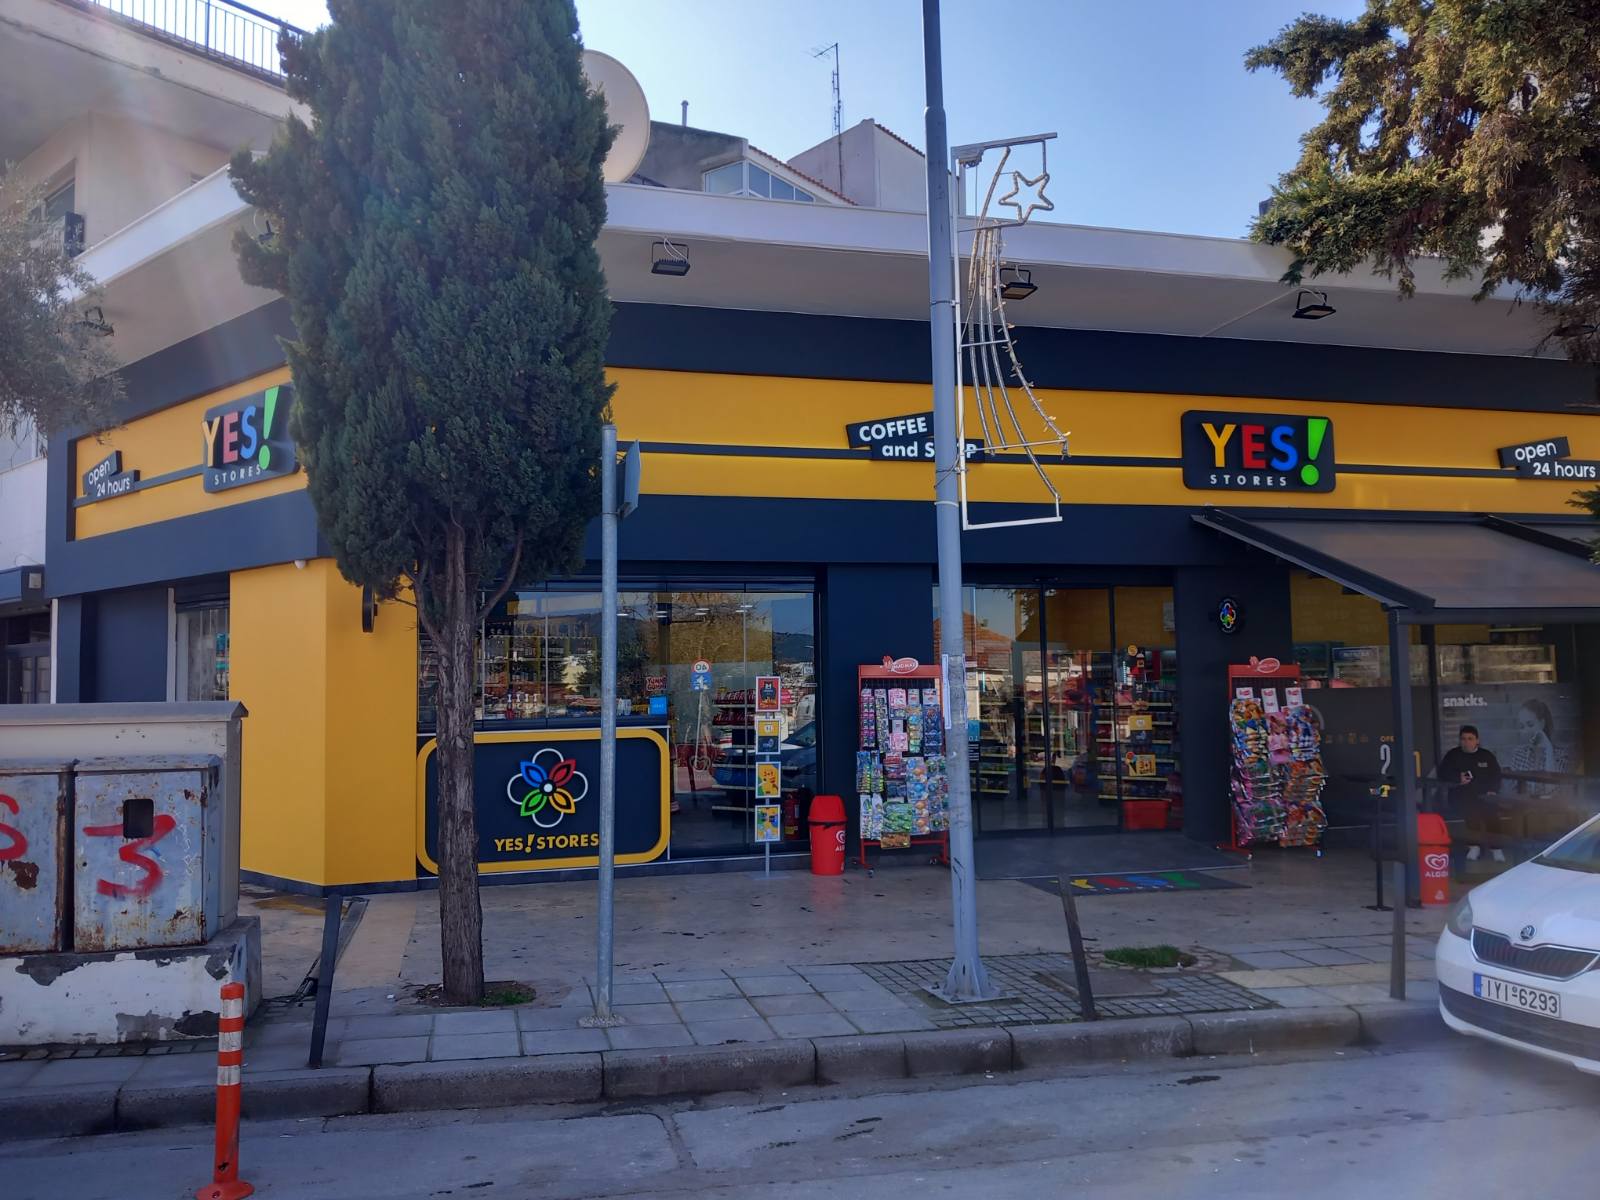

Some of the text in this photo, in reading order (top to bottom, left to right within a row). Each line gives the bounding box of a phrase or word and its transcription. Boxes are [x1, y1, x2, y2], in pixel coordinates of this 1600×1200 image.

[201, 384, 280, 470] YES!
[859, 416, 928, 442] COFFEE
[881, 441, 978, 459] and SP
[1201, 418, 1329, 486] YES!
[1514, 441, 1557, 463] open
[88, 459, 111, 487] open
[213, 465, 262, 486] STORES
[1532, 461, 1597, 478] 24 hours
[96, 475, 131, 497] 24 hours
[1209, 474, 1288, 487] STORES
[1443, 693, 1488, 707] snacks.
[494, 833, 600, 853] YES! STORES
